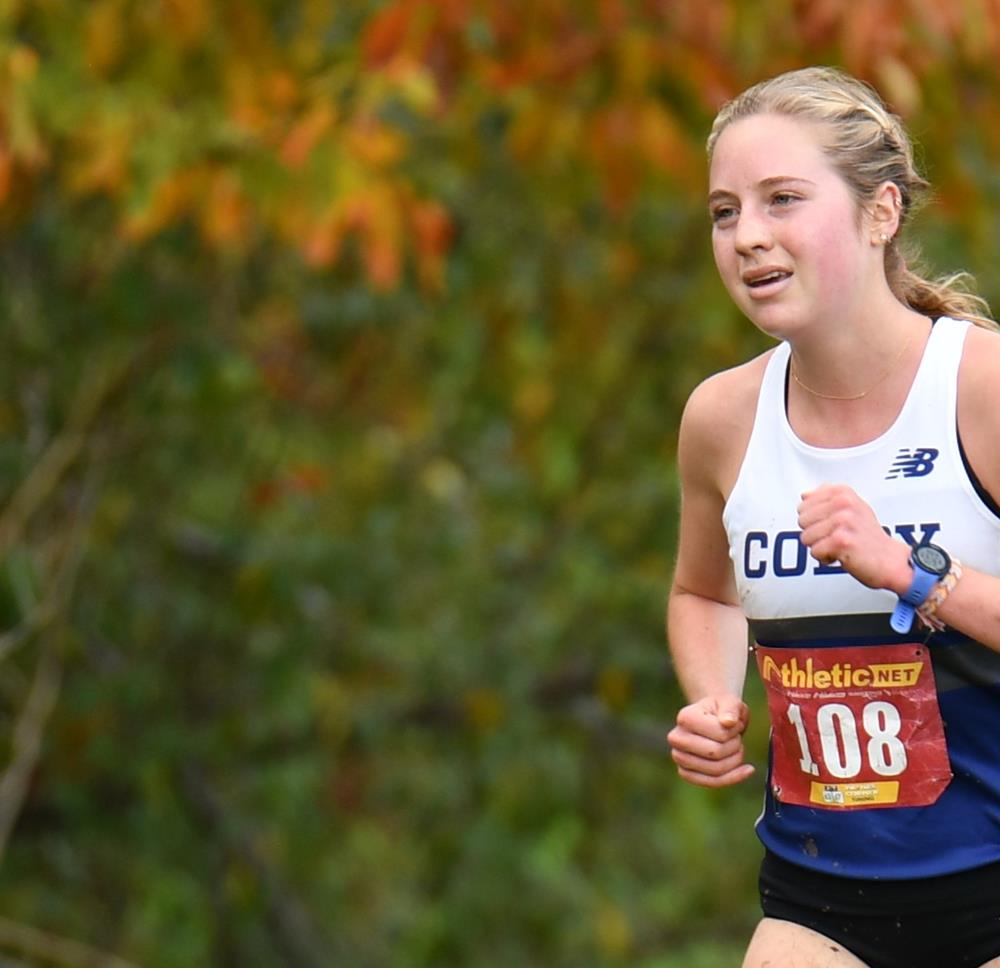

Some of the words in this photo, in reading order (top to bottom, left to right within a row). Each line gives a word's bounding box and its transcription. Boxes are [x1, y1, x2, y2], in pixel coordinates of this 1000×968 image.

[743, 522, 941, 579] COY
[878, 668, 916, 683] NET
[786, 700, 908, 779] 108
